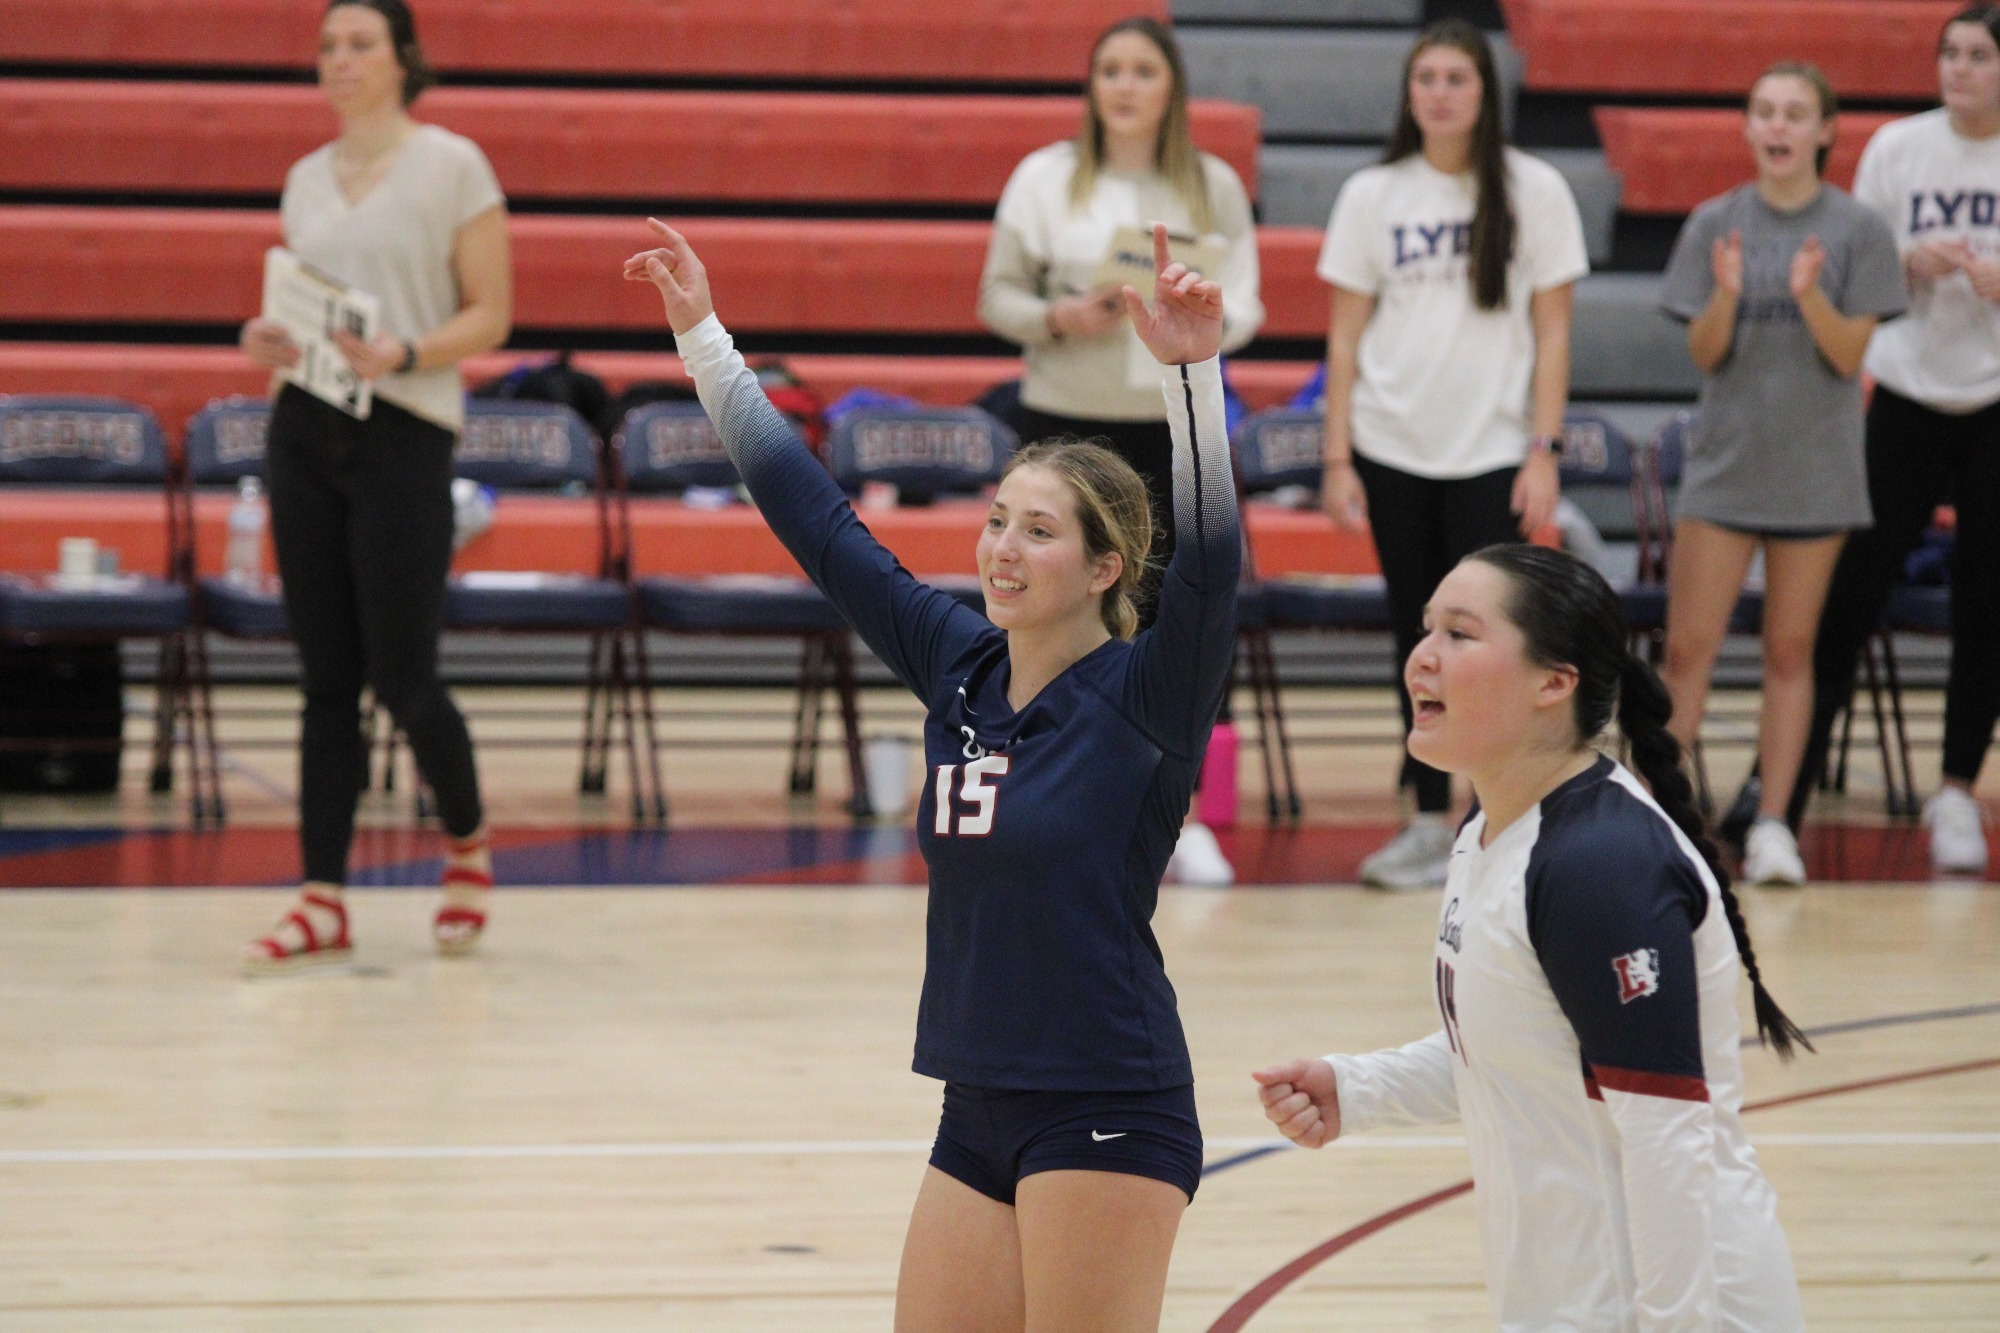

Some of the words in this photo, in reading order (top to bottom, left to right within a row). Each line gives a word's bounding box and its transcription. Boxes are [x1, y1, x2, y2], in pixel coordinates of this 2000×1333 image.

[1909, 190, 2000, 233] LYO
[852, 420, 993, 472] SCOTS
[934, 753, 1015, 837] 15
